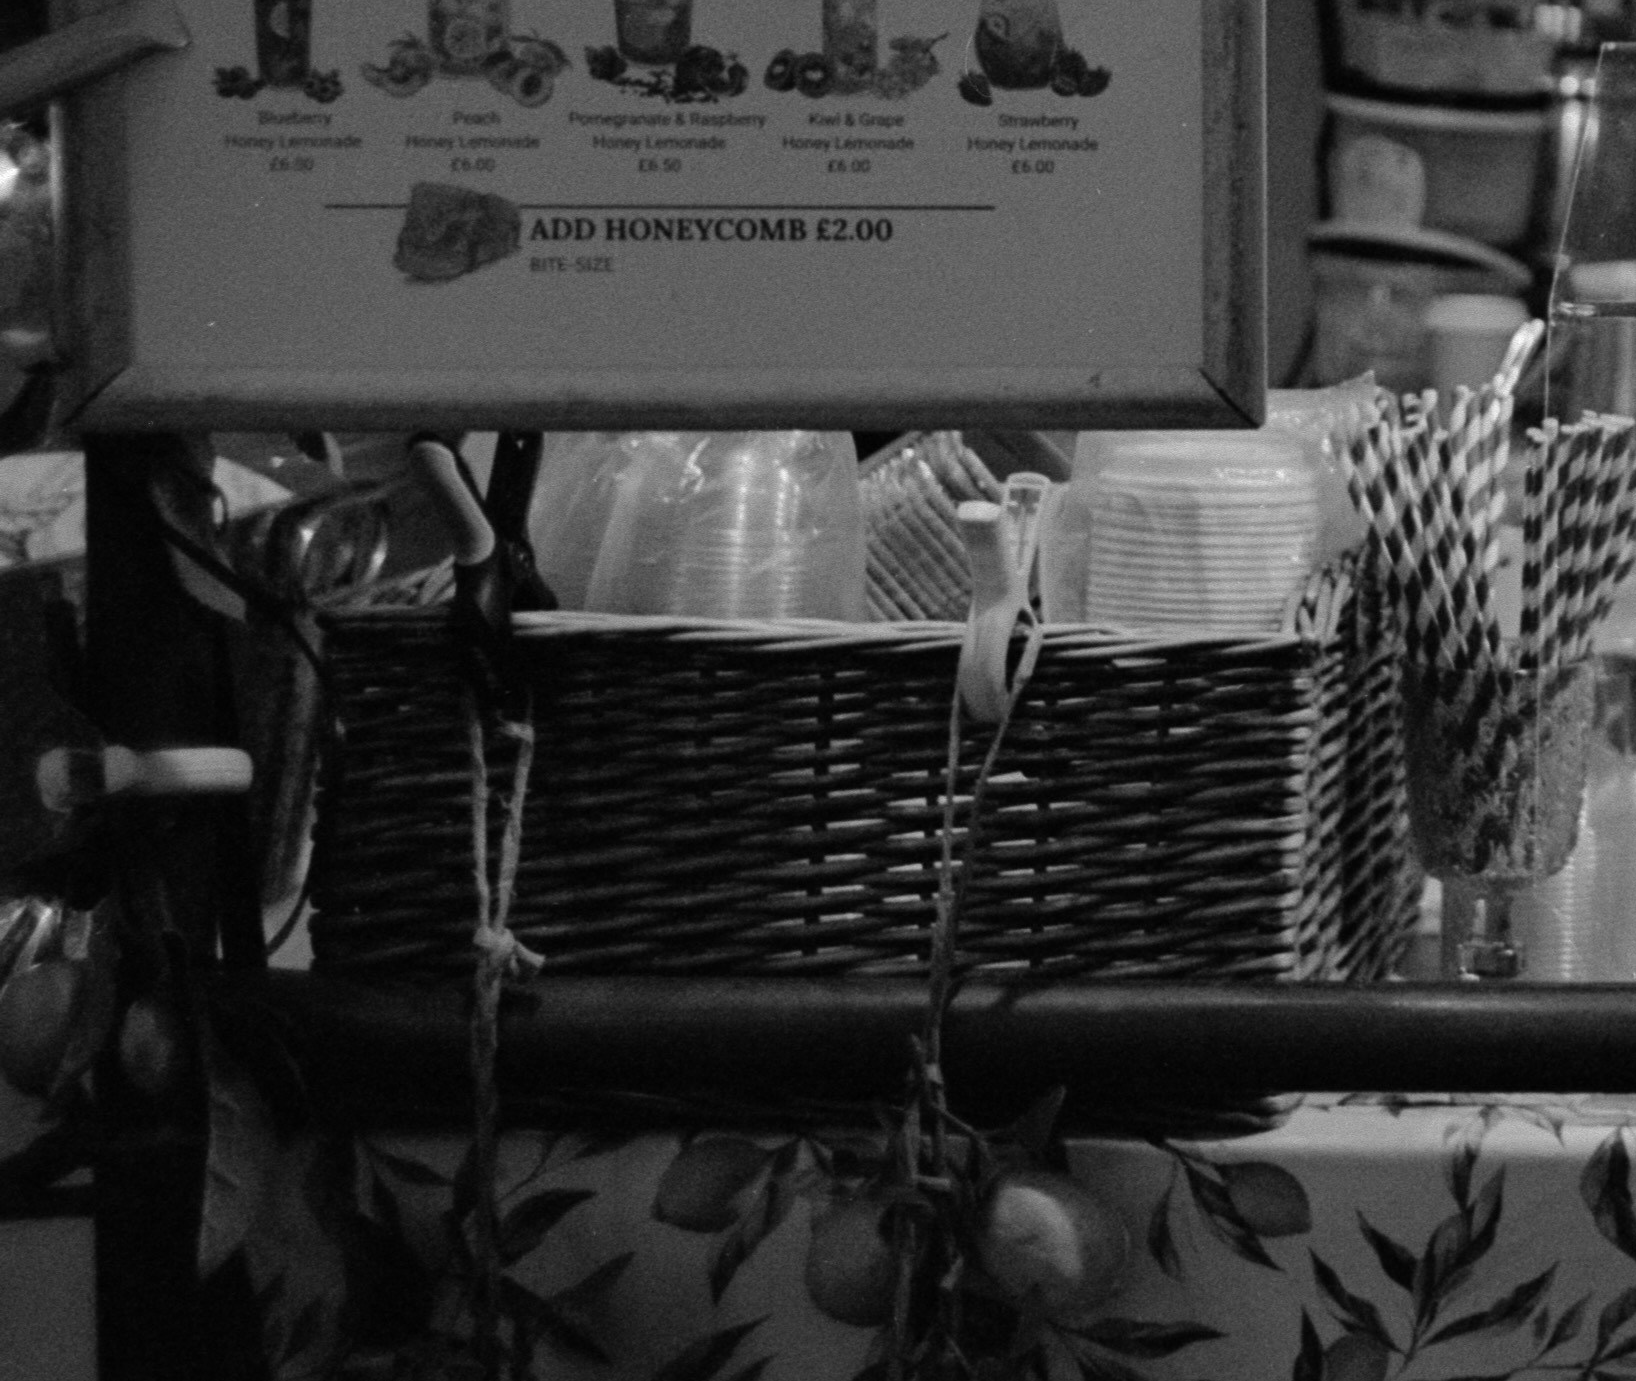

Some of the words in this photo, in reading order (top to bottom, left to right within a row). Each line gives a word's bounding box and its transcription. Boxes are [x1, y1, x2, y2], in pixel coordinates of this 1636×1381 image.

[257, 110, 332, 128] Blueberry
[452, 111, 502, 126] Peach
[568, 111, 671, 129] Pomegranate
[675, 113, 686, 127] &
[689, 113, 767, 130] Raspberry
[807, 112, 842, 128] Kiwi
[845, 113, 855, 128] &
[858, 113, 905, 131] Grape
[998, 113, 1079, 131] Strawberry
[224, 133, 276, 151] Honey
[278, 134, 362, 150] Lemonade
[405, 134, 455, 152] Honey
[457, 134, 540, 150] Lemonade
[592, 134, 642, 152] Honey
[644, 135, 727, 151] Lemonade
[782, 135, 831, 153] Honey
[834, 136, 915, 152] Lemonade
[967, 136, 1015, 154] Honey
[1019, 137, 1098, 152] Lemonade
[530, 217, 594, 242] ADD
[605, 217, 807, 243] HONEYCOMB
[815, 217, 894, 243] £2.00
[529, 256, 614, 274] BITE-SIZE
